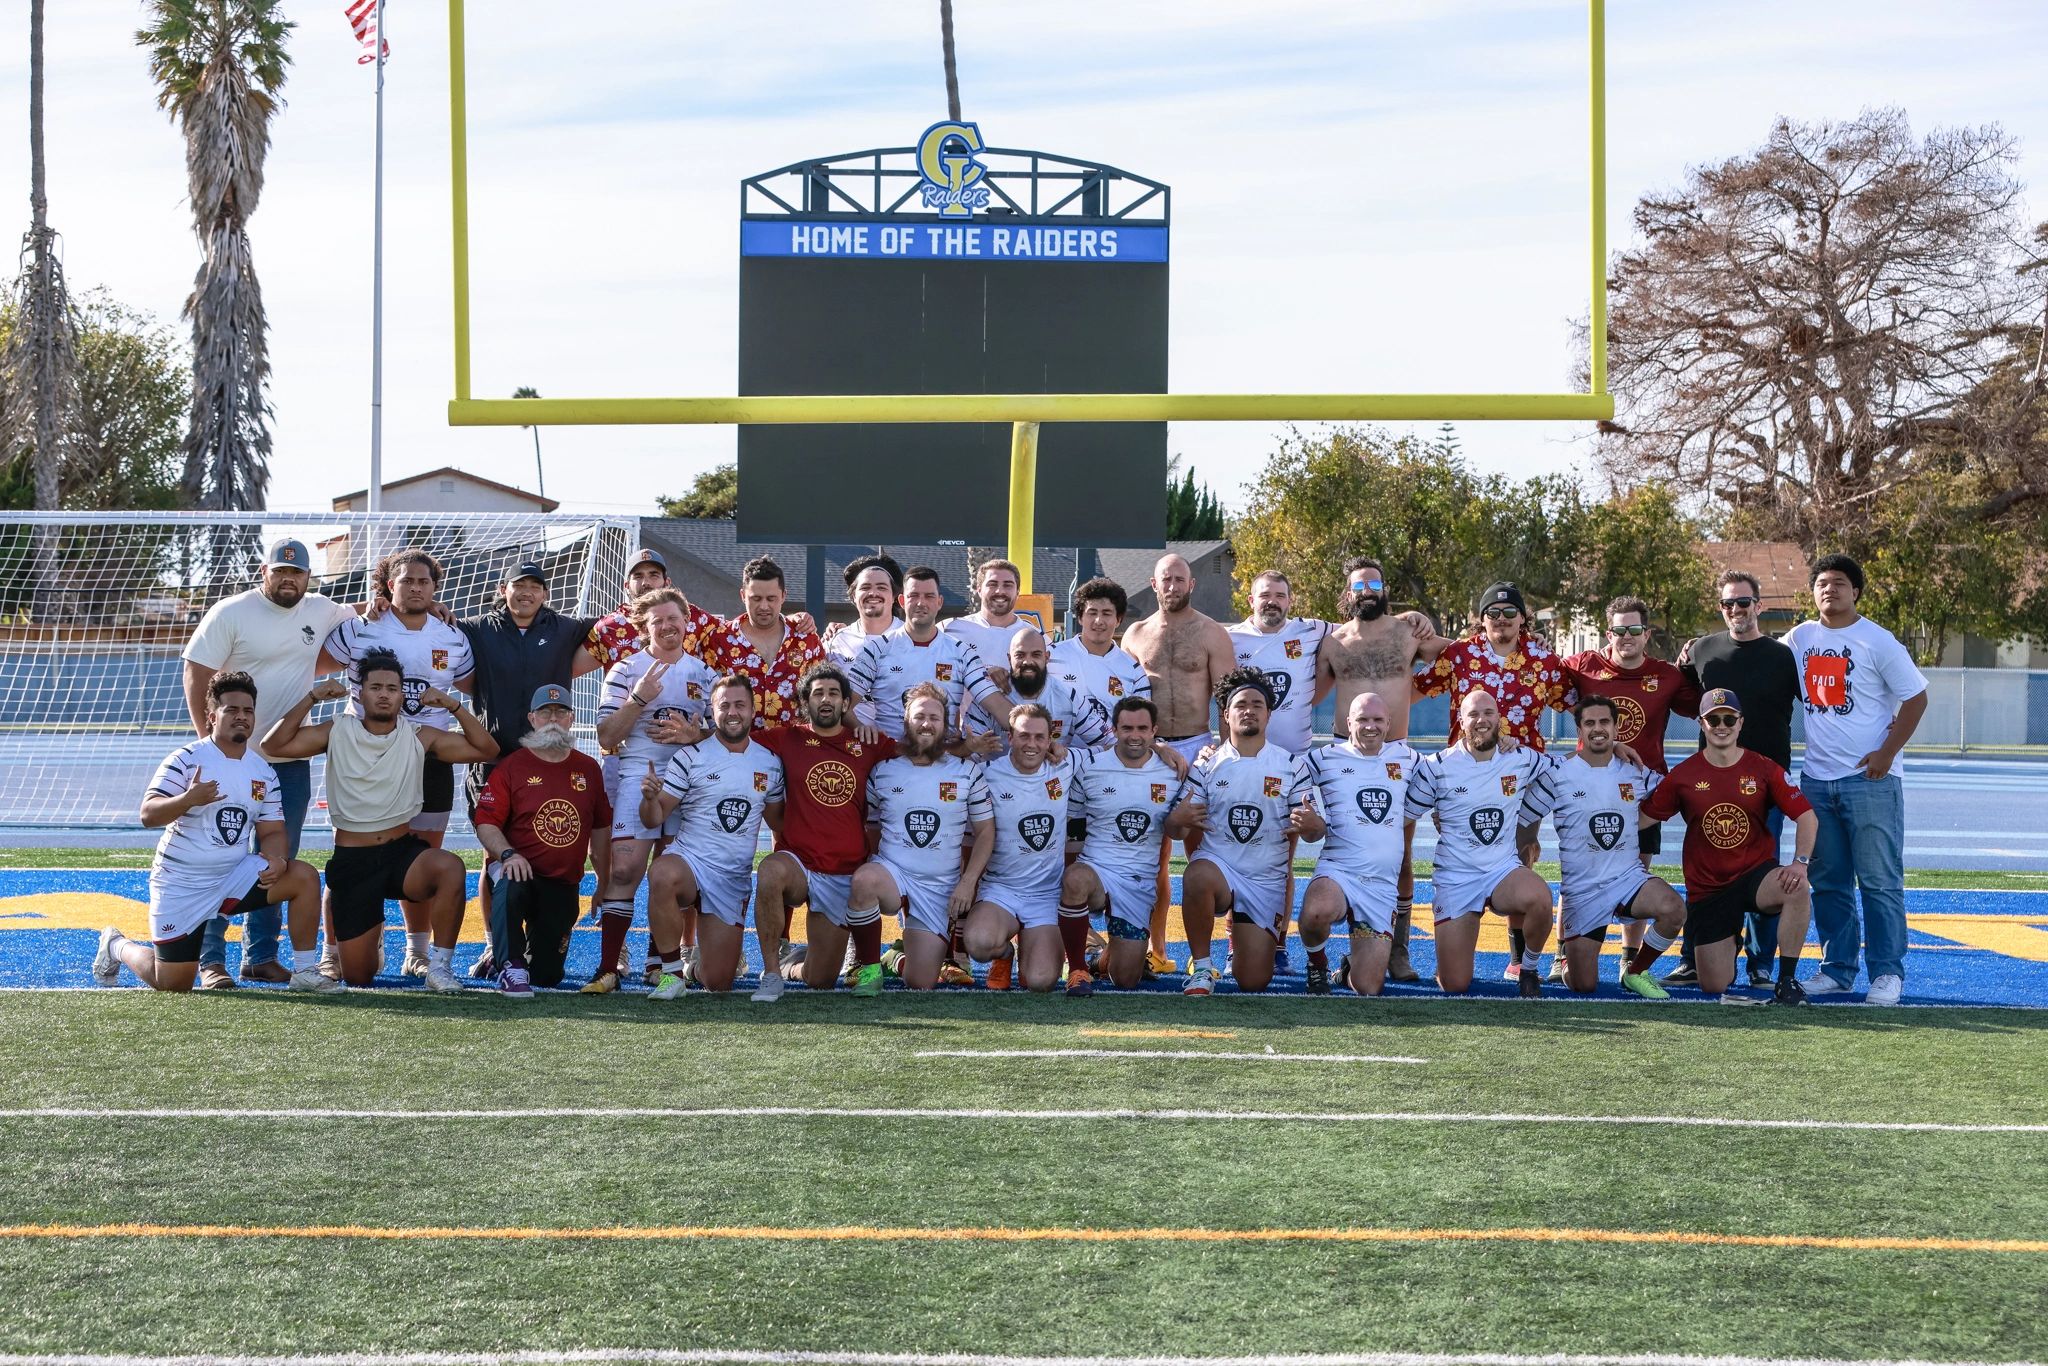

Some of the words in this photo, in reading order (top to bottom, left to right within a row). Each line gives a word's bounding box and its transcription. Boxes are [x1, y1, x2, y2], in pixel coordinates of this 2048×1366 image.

[922, 181, 989, 206] Raiders
[792, 226, 869, 254] HOME
[880, 228, 914, 254] OF
[927, 228, 981, 256] THE
[993, 228, 1117, 258] RAIDERS
[1812, 675, 1835, 686] PAID
[402, 682, 426, 692] SLO
[810, 773, 818, 790] ROD
[824, 764, 853, 795] HAMMER'S
[816, 792, 827, 801] SLO
[828, 795, 848, 803] STILL
[1362, 792, 1387, 802] SLO
[722, 801, 747, 811] SLO
[222, 810, 243, 822] SLO
[536, 814, 545, 830] ROD
[550, 802, 579, 832] HAMMER'S
[910, 814, 935, 824] SLO
[1121, 814, 1146, 823] SLO
[1232, 809, 1258, 819] SLO
[1475, 812, 1500, 823] SLO
[1717, 806, 1746, 833] HAMMER'S
[1024, 817, 1050, 830] SLO
[1595, 816, 1619, 827] SLO
[1025, 827, 1050, 836] BREW
[542, 832, 553, 841] SLO
[555, 834, 575, 843] STILLS
[1711, 836, 1721, 844] SLO
[1723, 835, 1742, 846] STILLS
